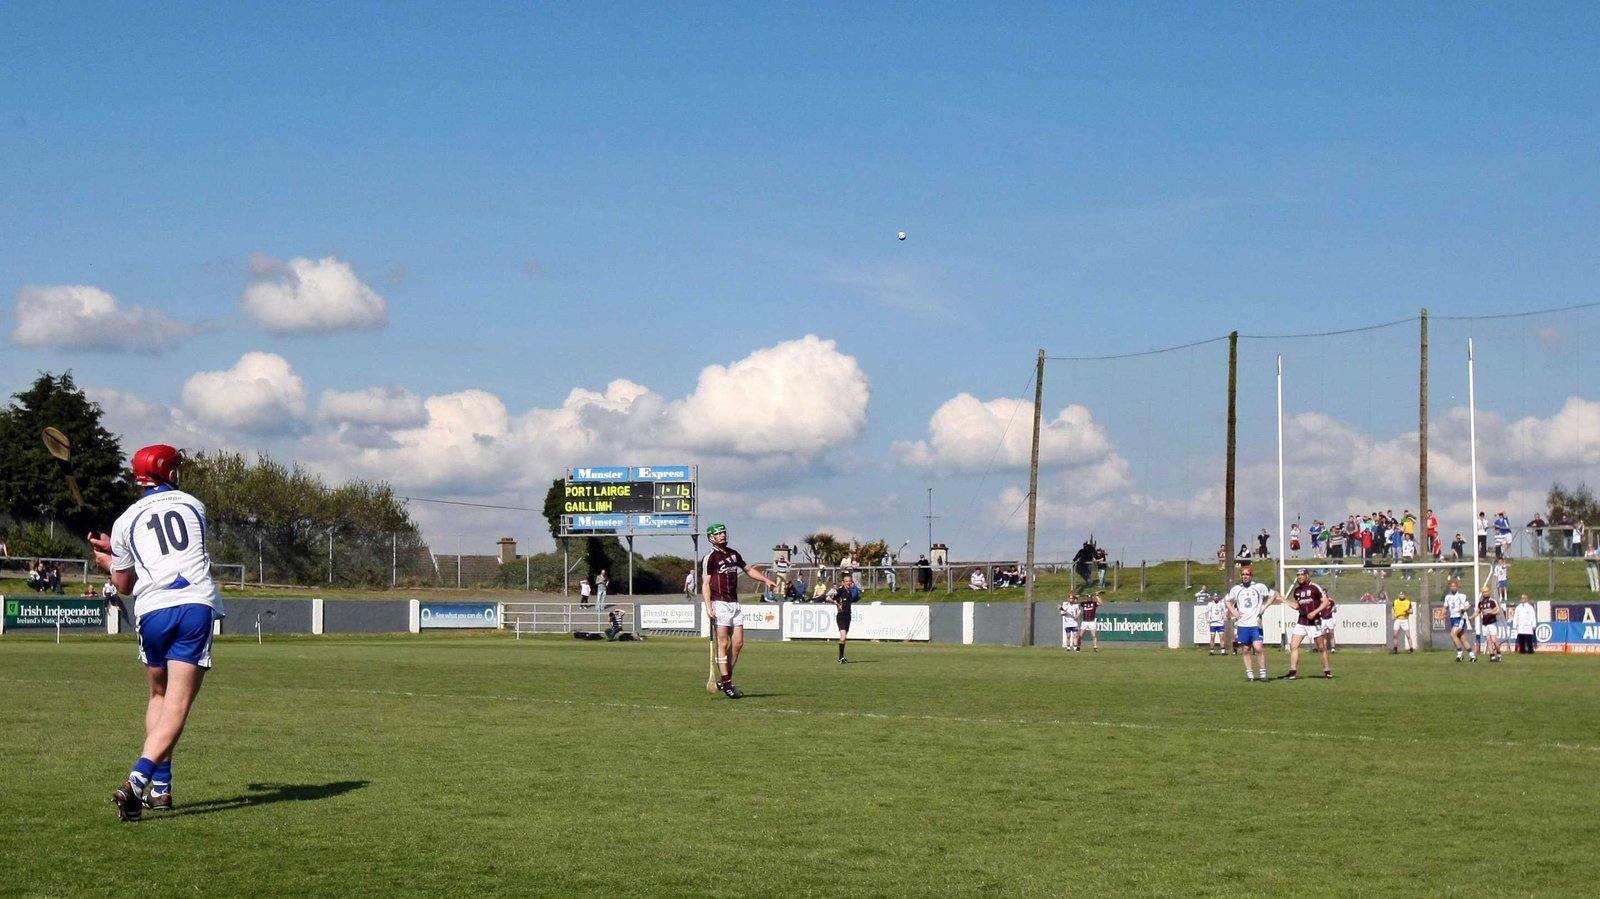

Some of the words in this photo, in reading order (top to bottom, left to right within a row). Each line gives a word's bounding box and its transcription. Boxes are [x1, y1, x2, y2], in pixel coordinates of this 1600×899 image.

[578, 468, 623, 479] Munster
[638, 467, 684, 479] Express
[565, 486, 592, 497] PORT
[594, 486, 631, 496] LAIRGE
[564, 501, 613, 512] GAILLIMH
[578, 516, 624, 527] Munster
[638, 515, 685, 528] Express
[146, 510, 189, 556] 10
[20, 605, 42, 616] Irish
[45, 605, 100, 618] Independent
[753, 611, 763, 622] tsb
[66, 617, 86, 625] Quality
[88, 617, 102, 625] Daily
[790, 609, 831, 633] FBD
[1113, 617, 1164, 634] Independent
[1342, 619, 1379, 629] three.ie
